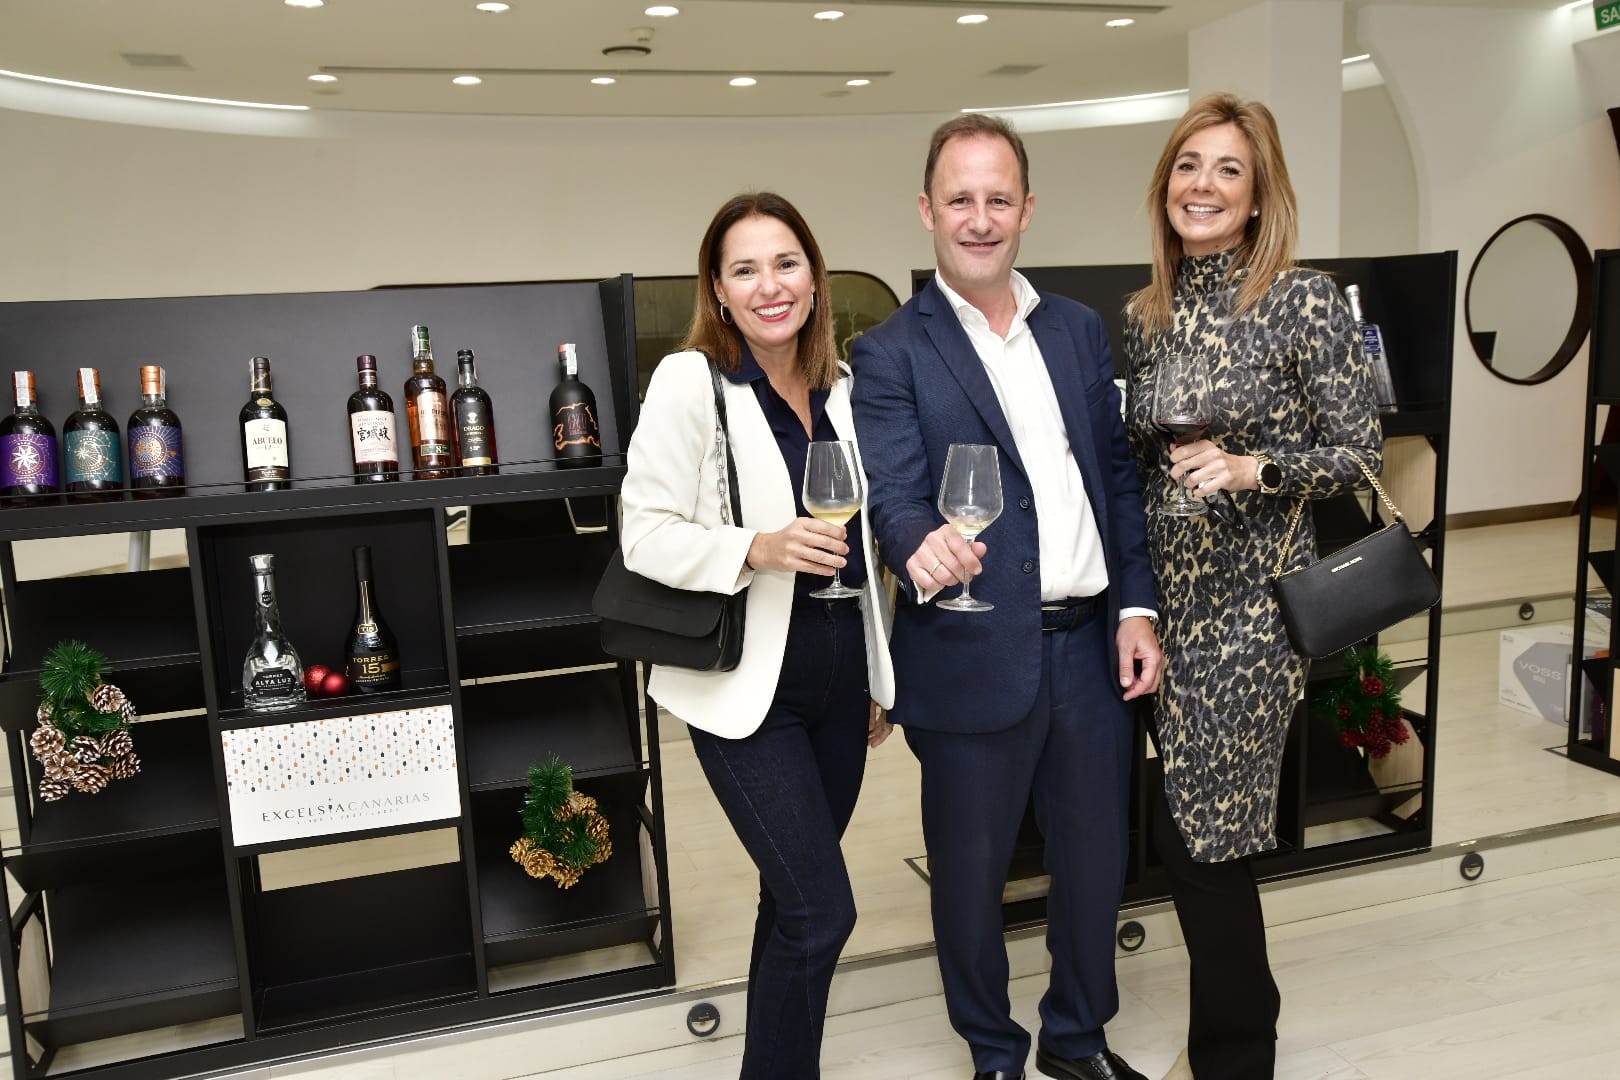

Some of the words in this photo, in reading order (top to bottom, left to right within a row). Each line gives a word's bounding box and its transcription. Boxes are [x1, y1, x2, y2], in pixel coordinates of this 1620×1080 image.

[1600, 5, 1620, 24] SA
[252, 436, 283, 446] ABUELO
[361, 661, 380, 674] 15
